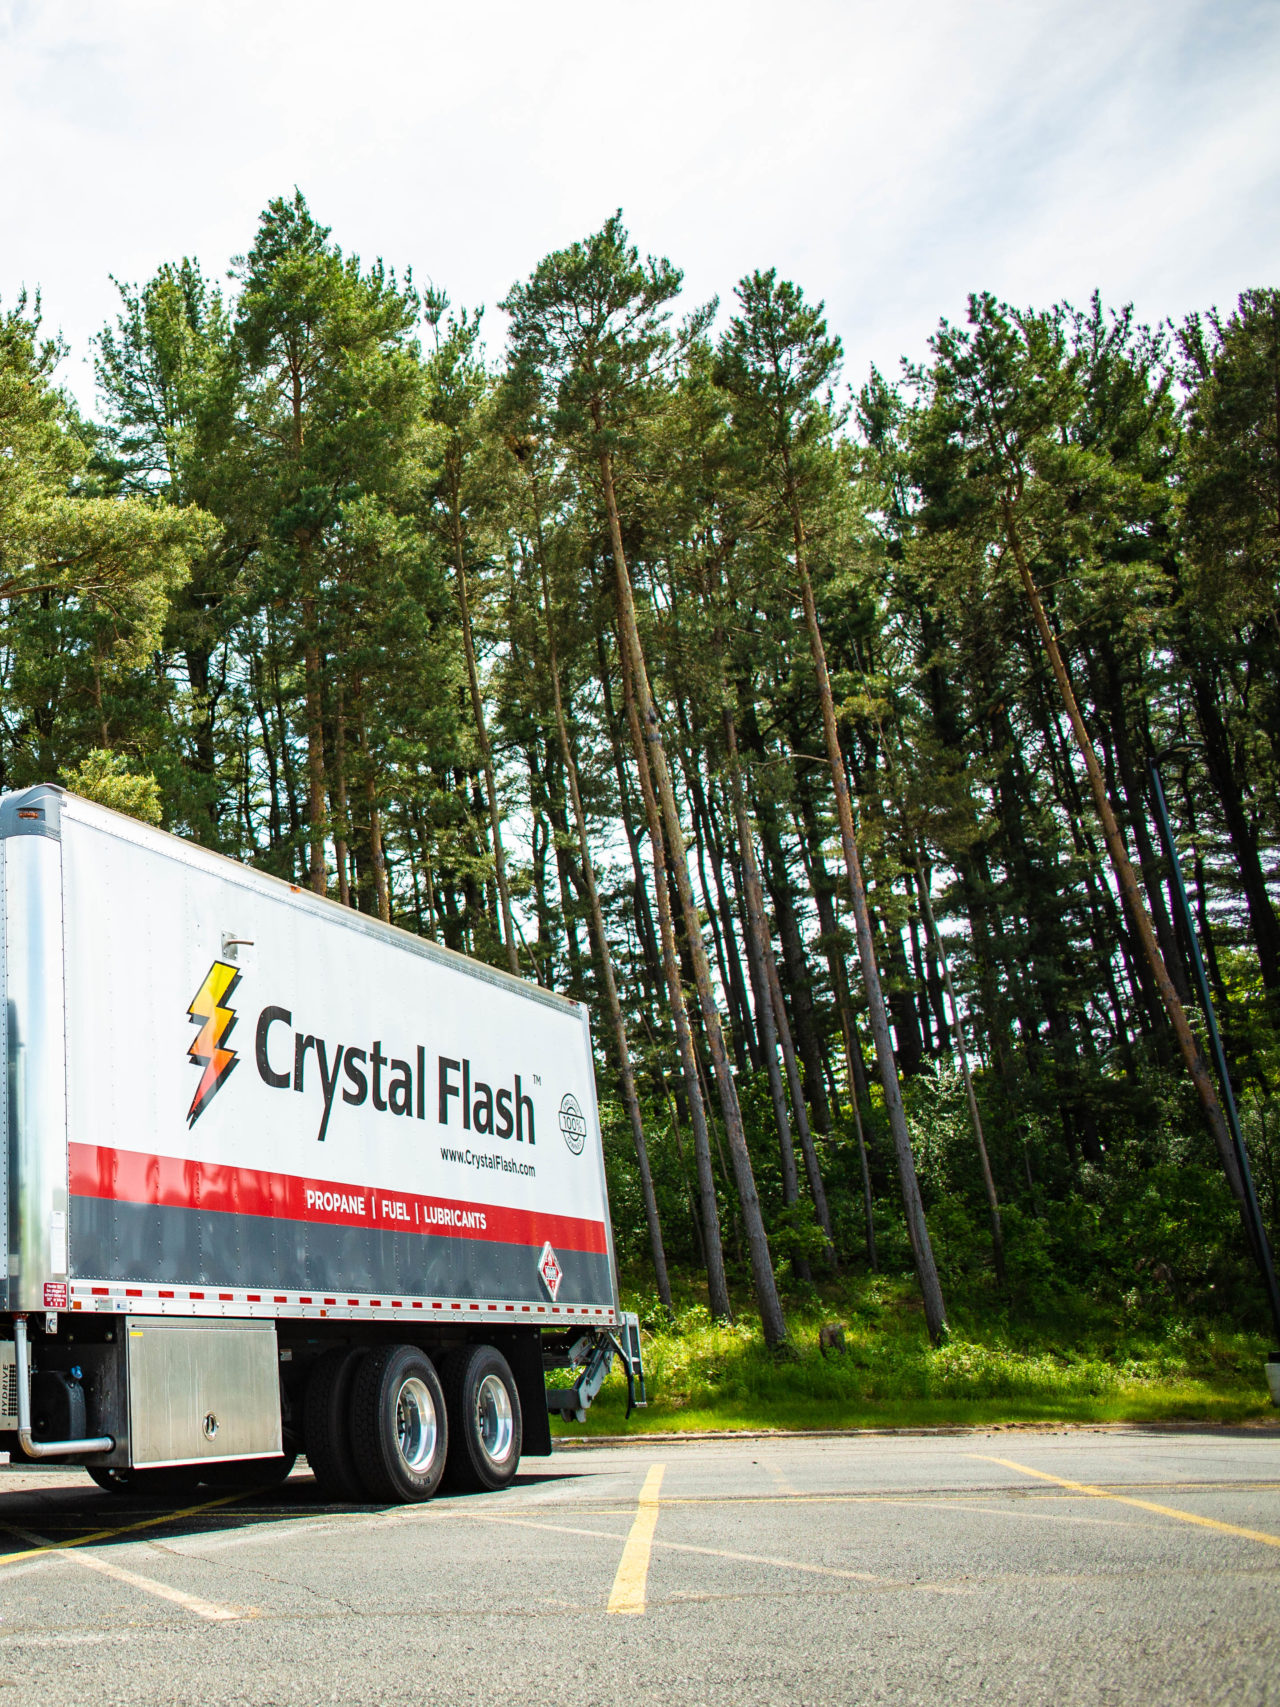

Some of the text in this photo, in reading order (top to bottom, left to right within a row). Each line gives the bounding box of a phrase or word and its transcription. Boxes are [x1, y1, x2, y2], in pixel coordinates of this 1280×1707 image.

[255, 1005, 426, 1142] Crystal
[438, 1055, 536, 1146] Flash
[563, 1115, 583, 1133] 100%
[440, 1147, 536, 1177] www.CrystalFlash.com
[306, 1189, 487, 1229] PROPANE FUEL LUBRICANTS
[1, 1363, 9, 1416] HYDRIVE
